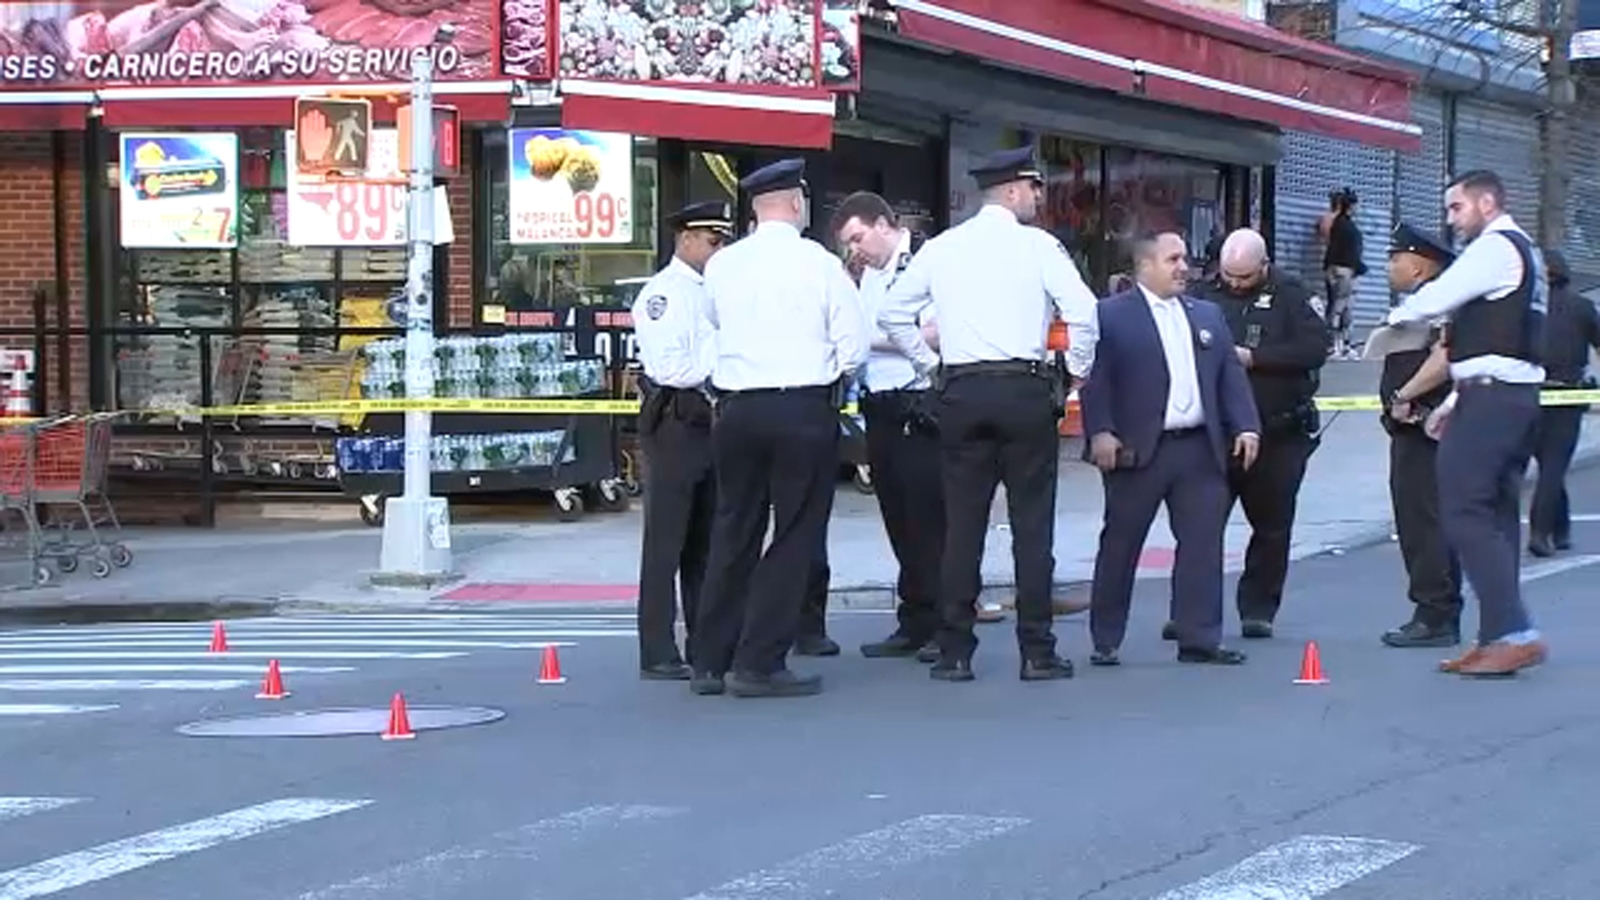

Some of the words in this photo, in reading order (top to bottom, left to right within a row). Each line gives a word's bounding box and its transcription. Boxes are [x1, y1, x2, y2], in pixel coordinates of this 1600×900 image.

[0, 55, 56, 79] SES
[84, 51, 244, 78] CARNICERO
[253, 51, 271, 76] A
[281, 49, 318, 74] SU
